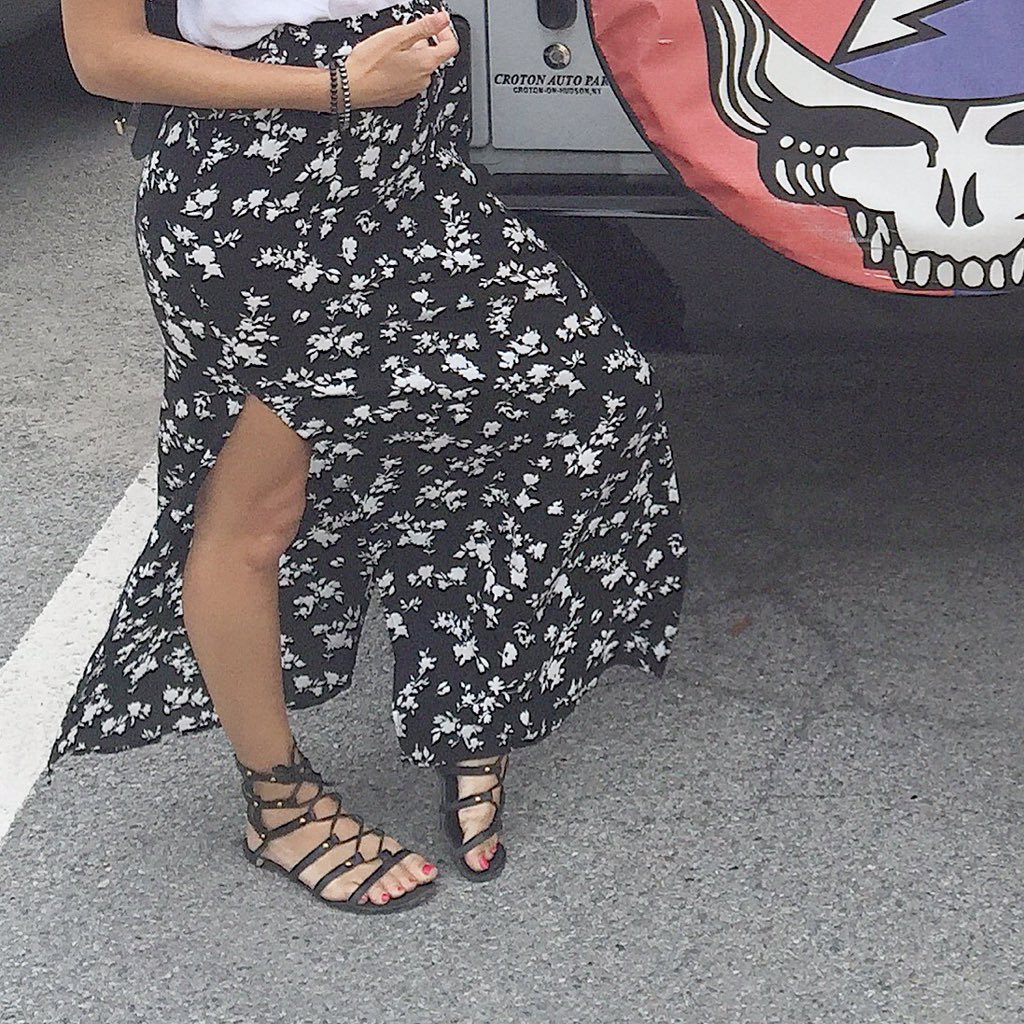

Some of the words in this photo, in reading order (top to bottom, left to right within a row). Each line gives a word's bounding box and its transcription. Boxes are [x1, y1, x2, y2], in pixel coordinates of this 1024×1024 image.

[494, 73, 546, 85] CROTON
[547, 75, 583, 86] AUTO
[585, 75, 610, 87] PAR
